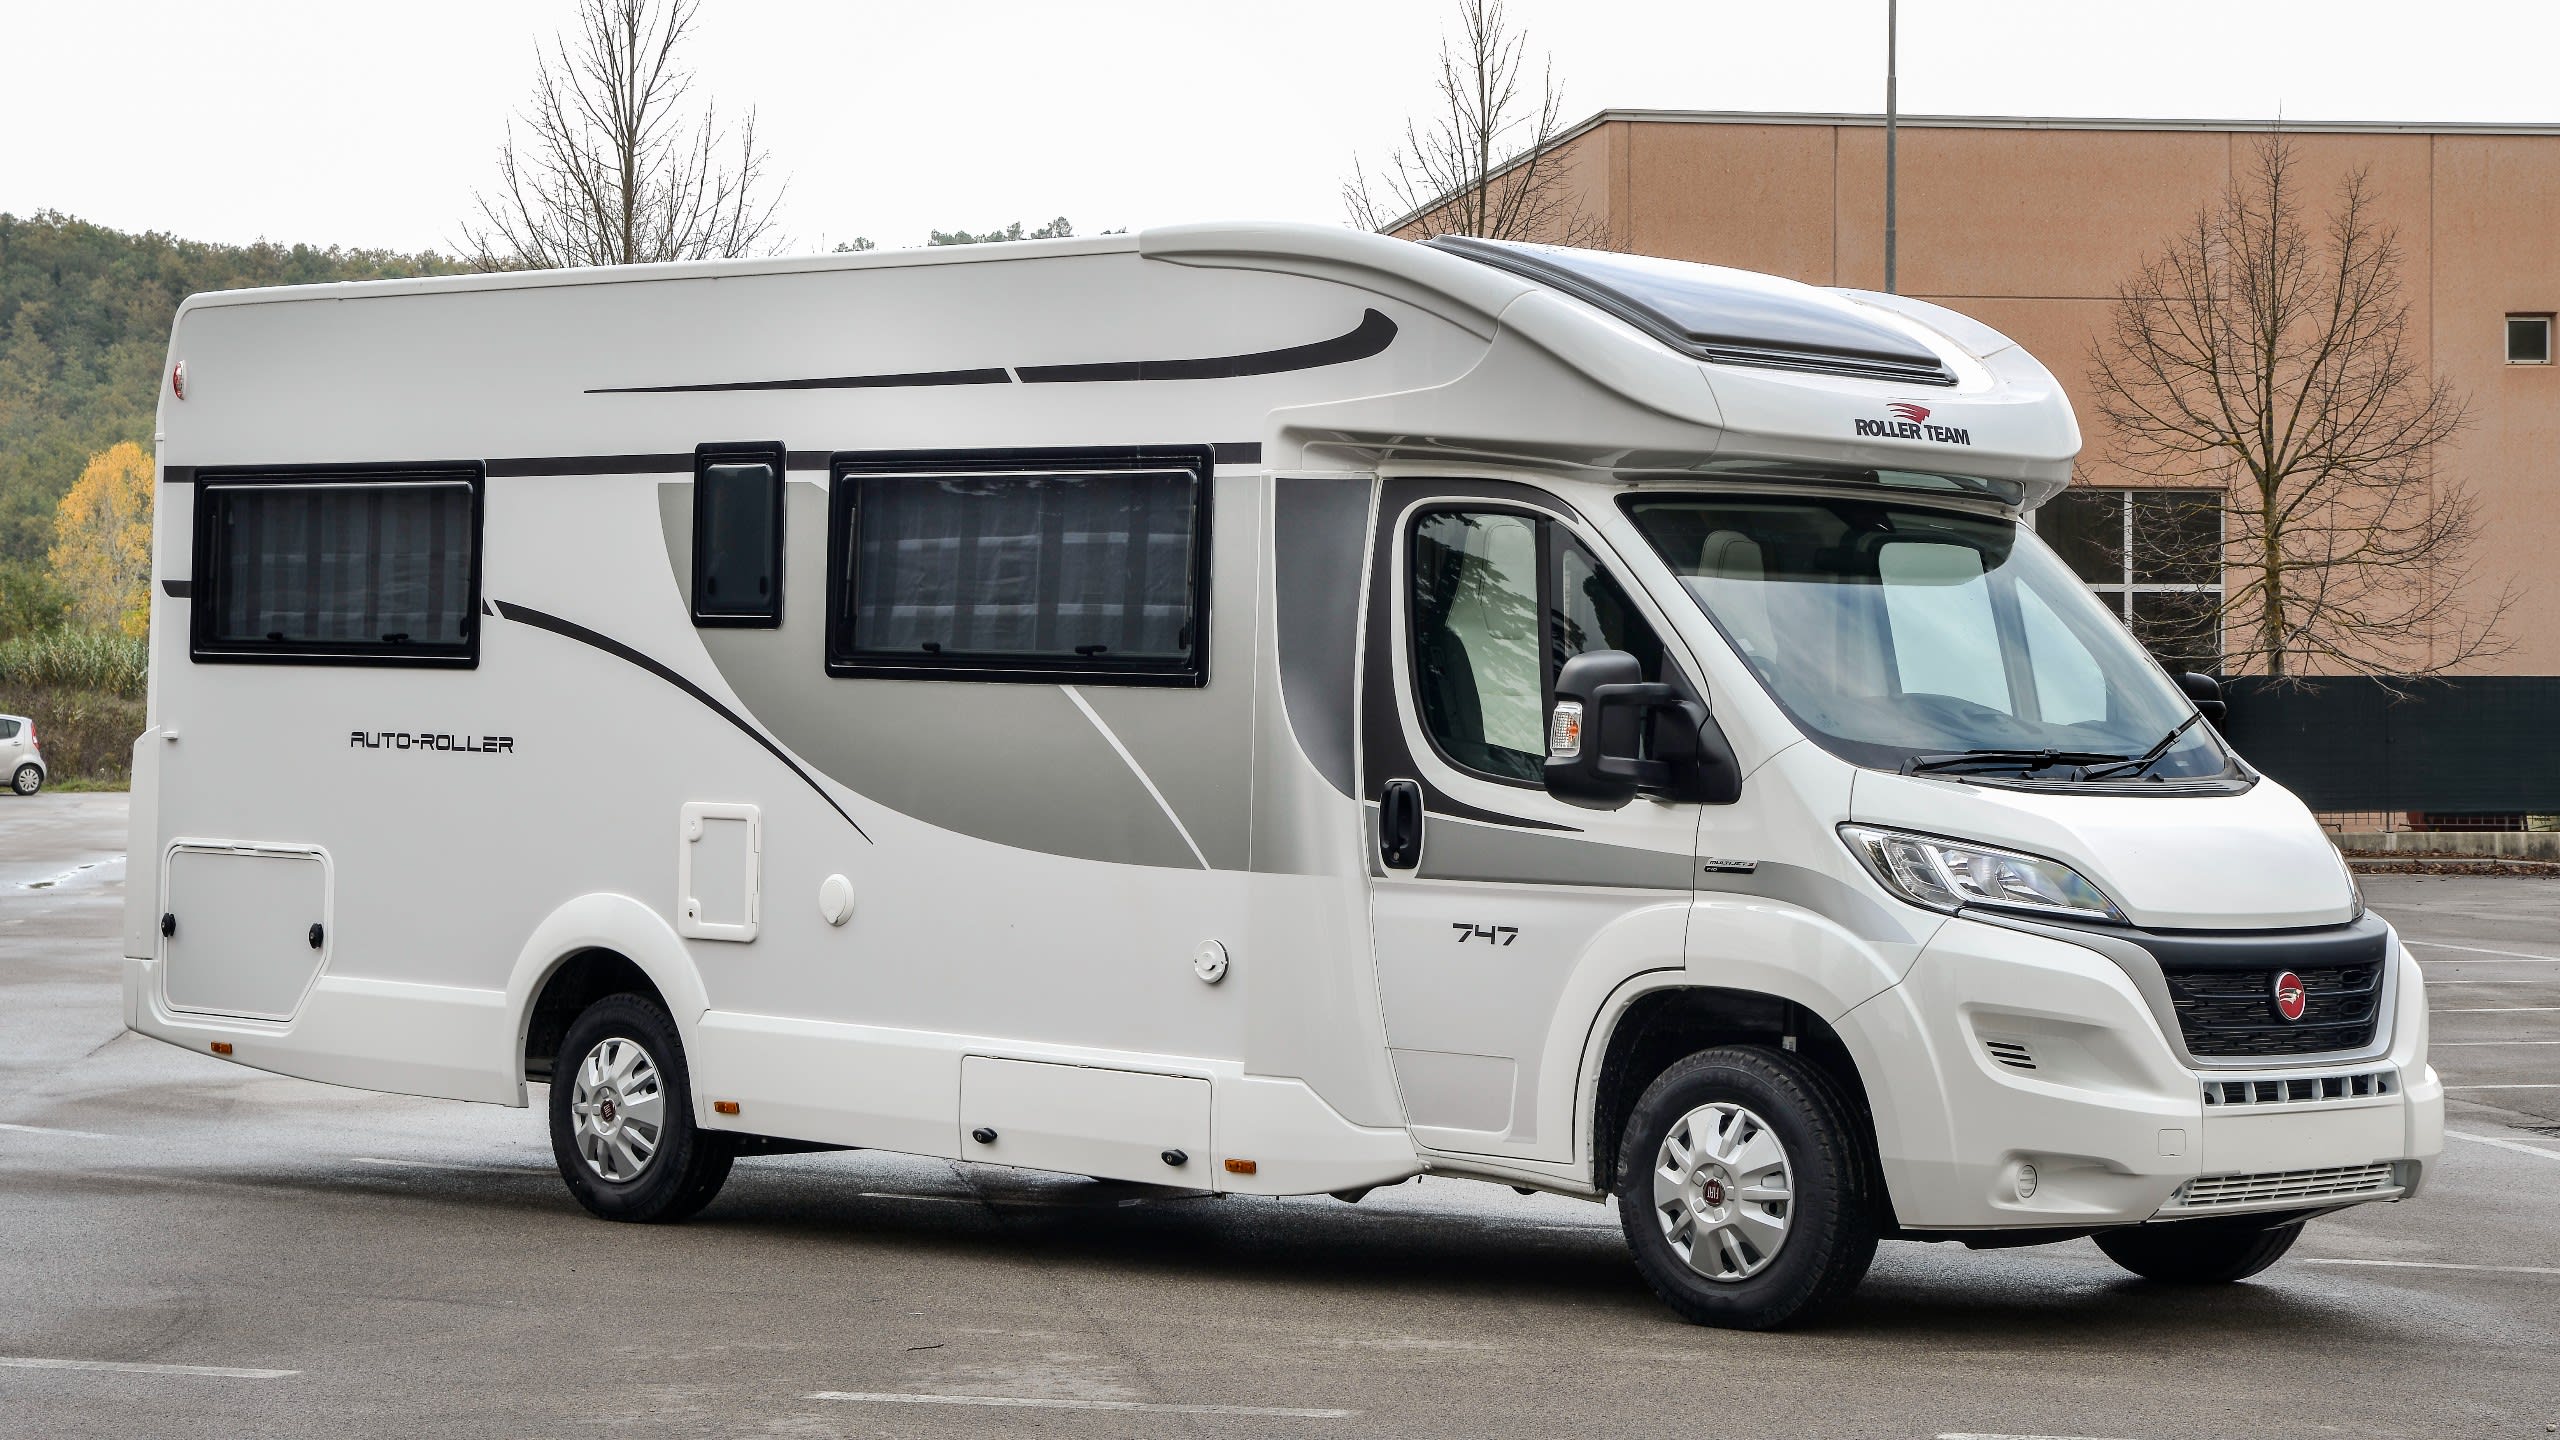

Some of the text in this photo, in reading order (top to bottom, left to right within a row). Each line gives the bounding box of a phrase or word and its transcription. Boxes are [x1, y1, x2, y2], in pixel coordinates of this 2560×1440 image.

[1855, 419, 1971, 446] ROLLER TEAM
[350, 731, 514, 754] AUTO-ROLLER
[1452, 922, 1519, 946] 747
[1707, 1186, 1719, 1199] FIAT
